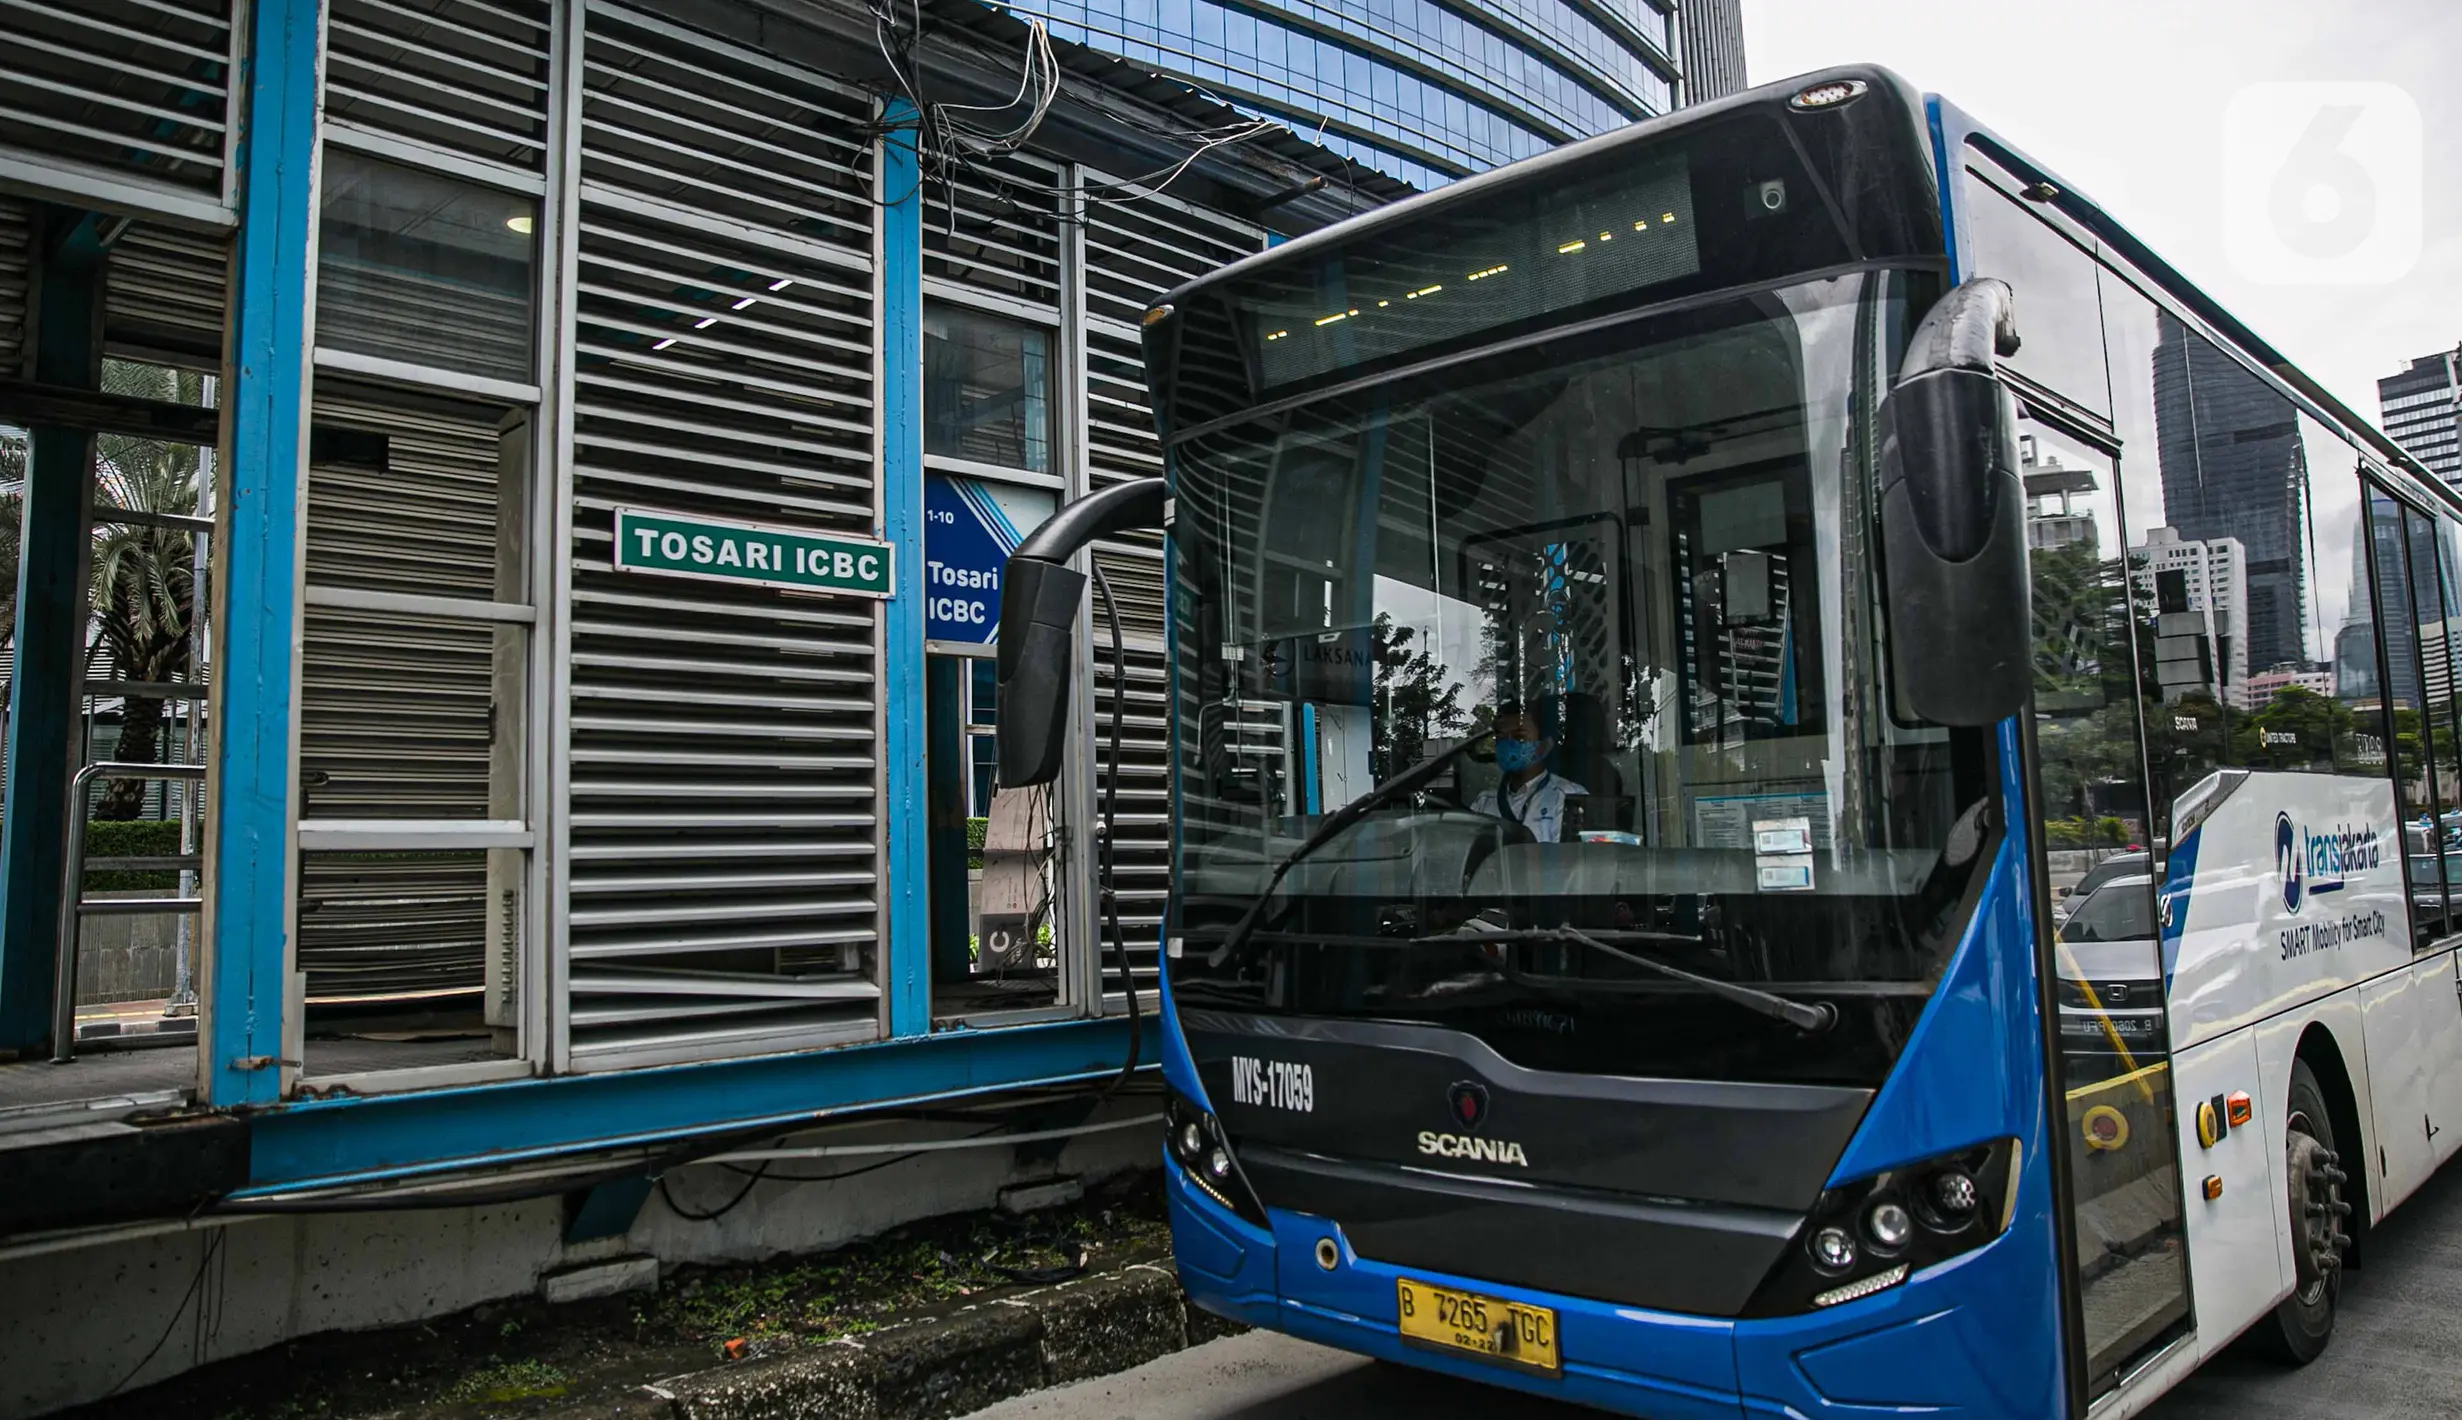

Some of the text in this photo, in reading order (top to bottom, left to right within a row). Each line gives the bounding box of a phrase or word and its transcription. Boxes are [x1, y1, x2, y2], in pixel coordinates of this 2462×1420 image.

[927, 509, 954, 525] 1-10
[634, 528, 880, 581] TOSARI ICBC
[928, 561, 998, 590] Tosari
[929, 598, 985, 624] ICBC
[1303, 644, 1372, 667] LAKSANA
[2304, 822, 2379, 880] transjakarta
[2280, 910, 2386, 961] SMART Mobility for Smart City
[1232, 1056, 1313, 1112] MYS-17059
[1417, 1131, 1528, 1166] SCANIA
[1401, 1287, 1550, 1347] B 7265 TGC
